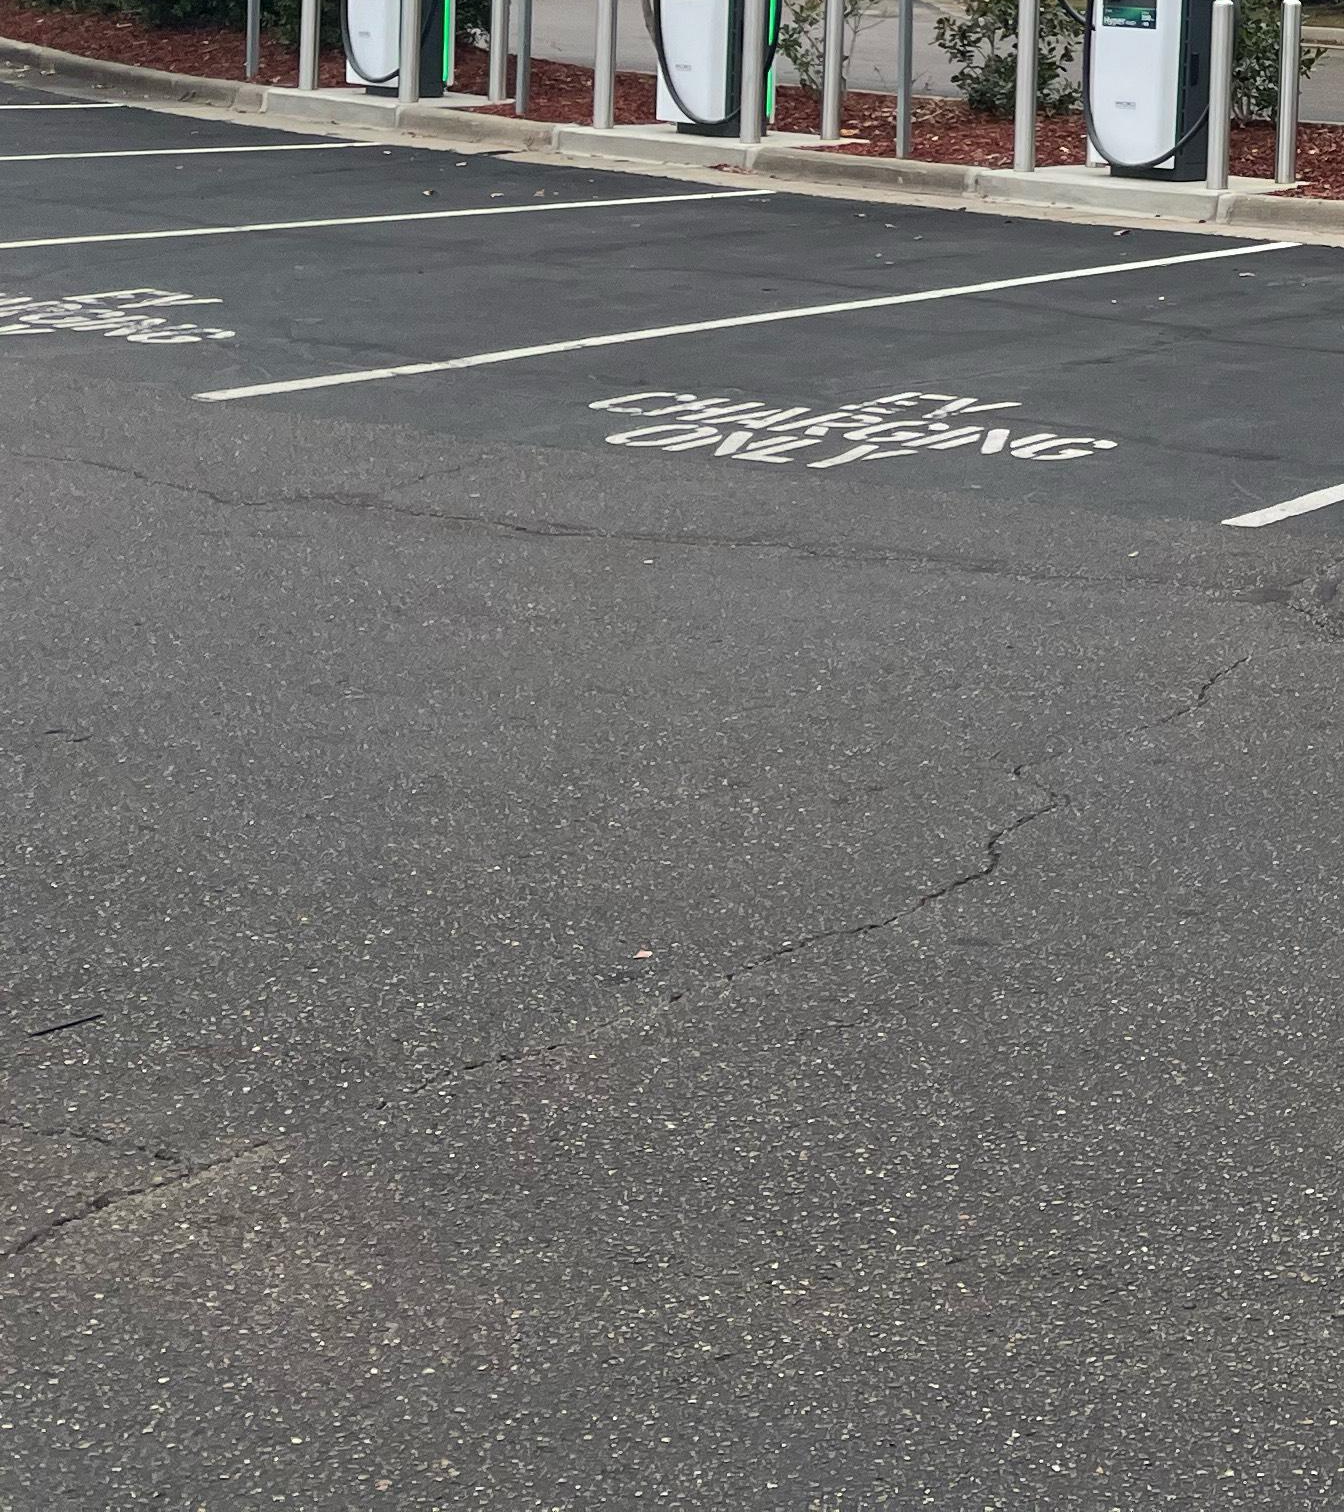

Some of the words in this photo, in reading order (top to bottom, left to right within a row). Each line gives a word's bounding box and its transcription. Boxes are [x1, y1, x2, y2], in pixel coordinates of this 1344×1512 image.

[587, 391, 1118, 461] CHARGING
[838, 391, 1023, 419] EV
[604, 424, 918, 469] ONLY
